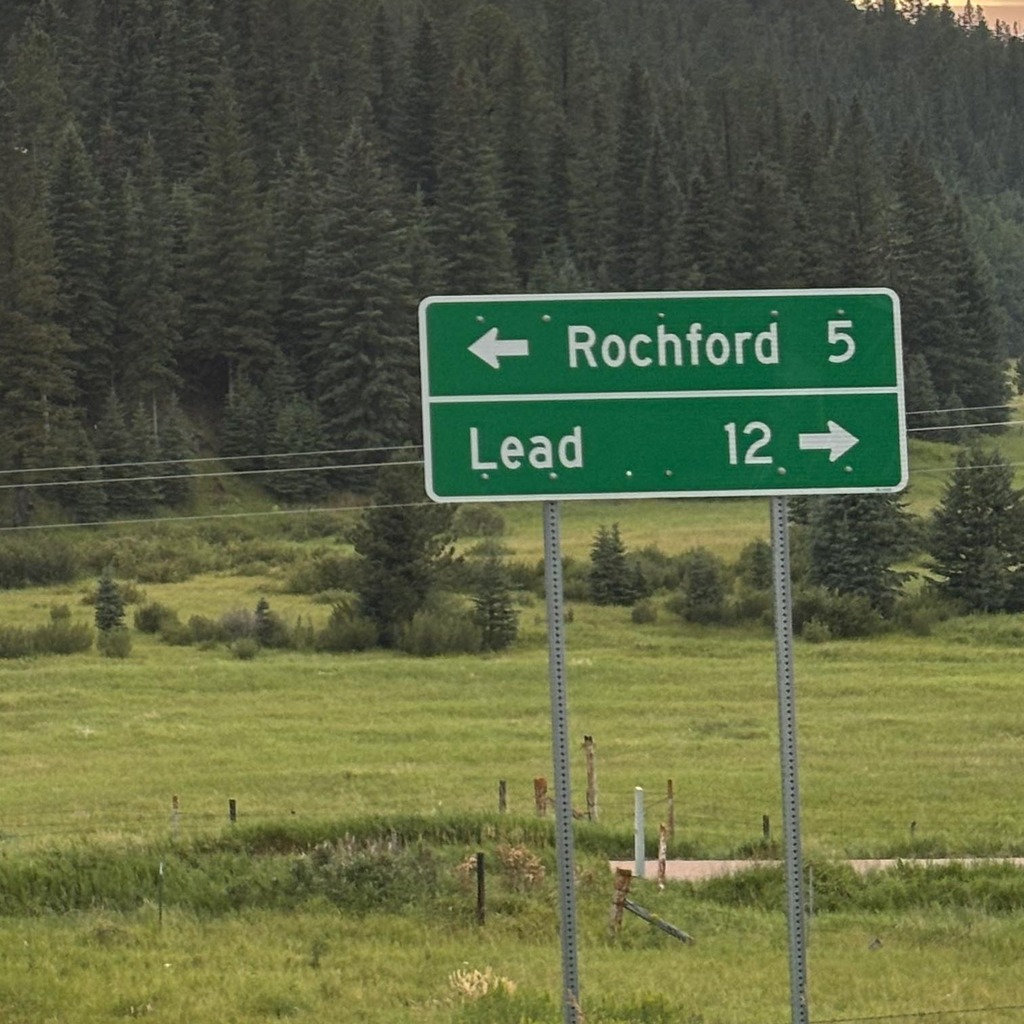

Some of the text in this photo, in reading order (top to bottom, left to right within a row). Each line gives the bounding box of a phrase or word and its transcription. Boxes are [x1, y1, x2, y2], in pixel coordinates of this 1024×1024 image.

[568, 320, 856, 368] Rochford 5
[470, 421, 773, 470] Lead 12
